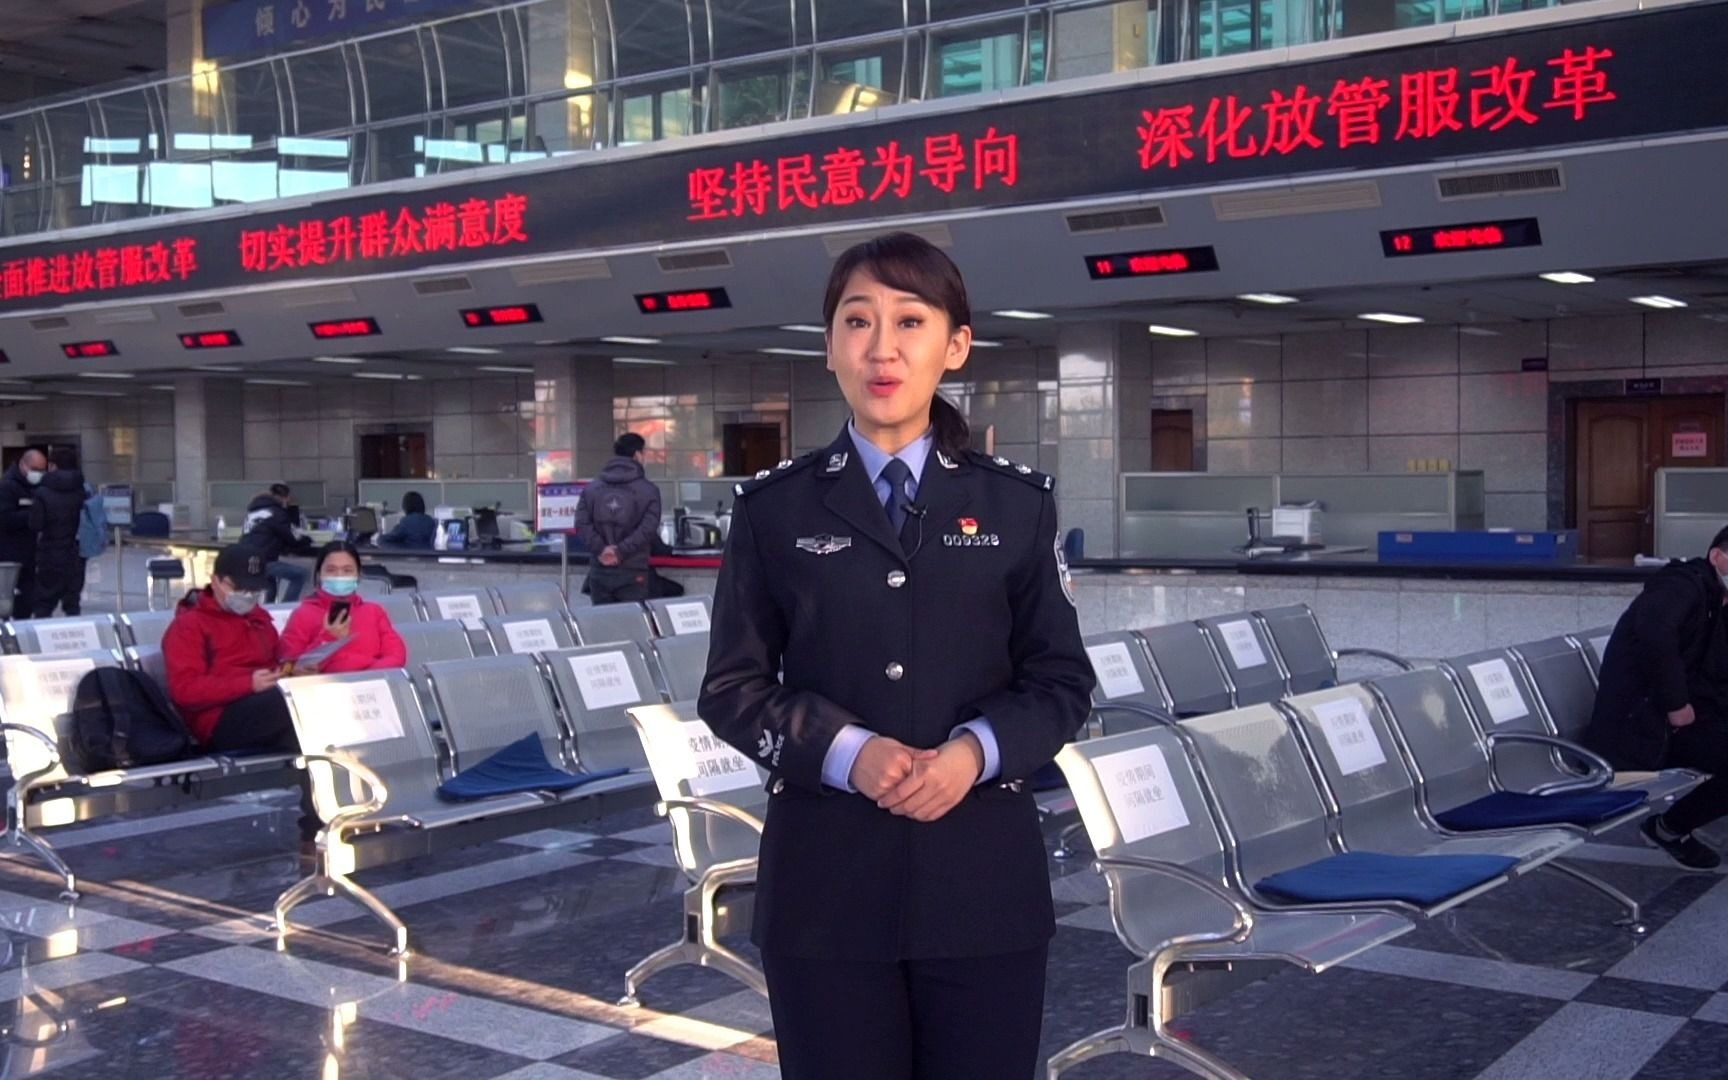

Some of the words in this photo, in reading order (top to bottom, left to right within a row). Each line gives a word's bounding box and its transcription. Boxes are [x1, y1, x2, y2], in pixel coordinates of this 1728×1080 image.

[1136, 46, 1616, 170] 深化放管服改革
[687, 127, 1019, 221] 坚持民意为导向
[0, 236, 197, 299] 面推进放管服改革
[240, 193, 528, 272] 切实提升群众满意度
[943, 534, 1000, 546] 009328
